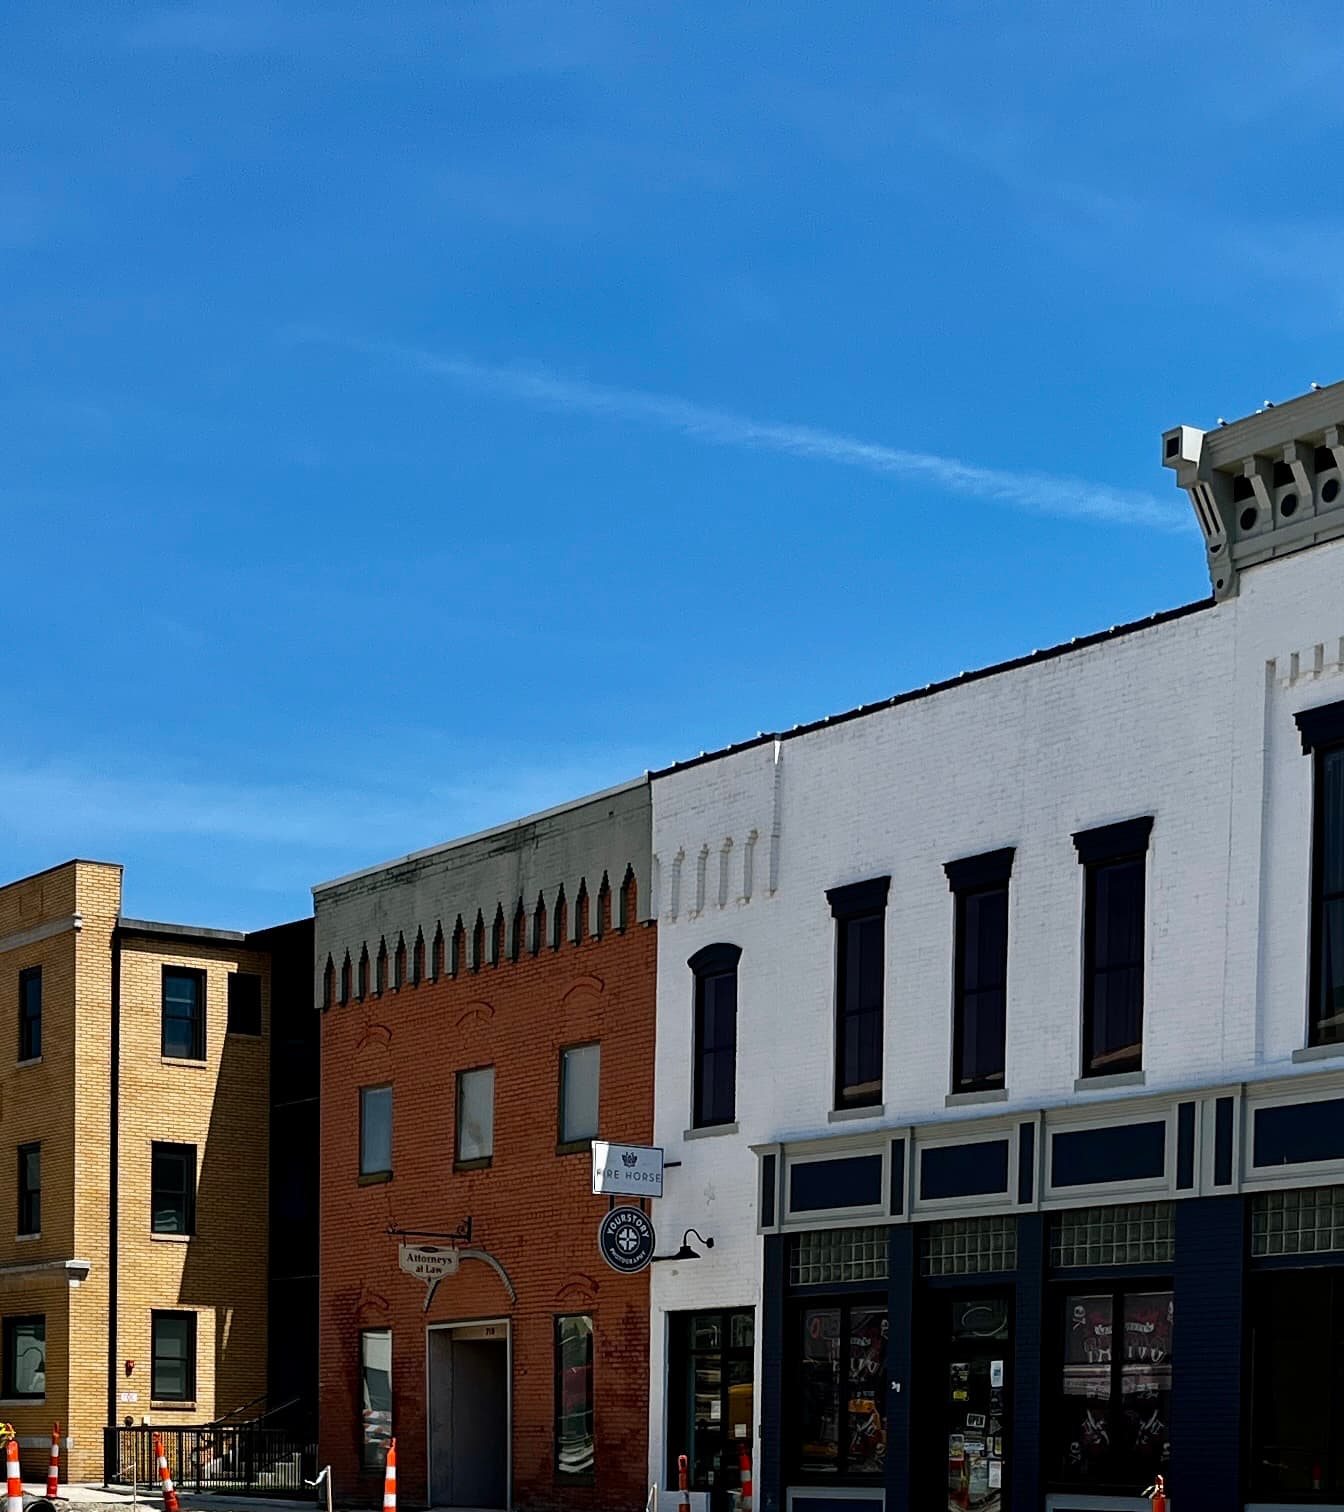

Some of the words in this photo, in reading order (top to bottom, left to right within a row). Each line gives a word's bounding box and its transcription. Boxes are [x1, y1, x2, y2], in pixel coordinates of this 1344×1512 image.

[596, 1169, 620, 1180] FRE
[625, 1172, 662, 1184] HORSE
[407, 1253, 453, 1265] Attorneys
[416, 1265, 424, 1273] at
[425, 1265, 443, 1274] Law
